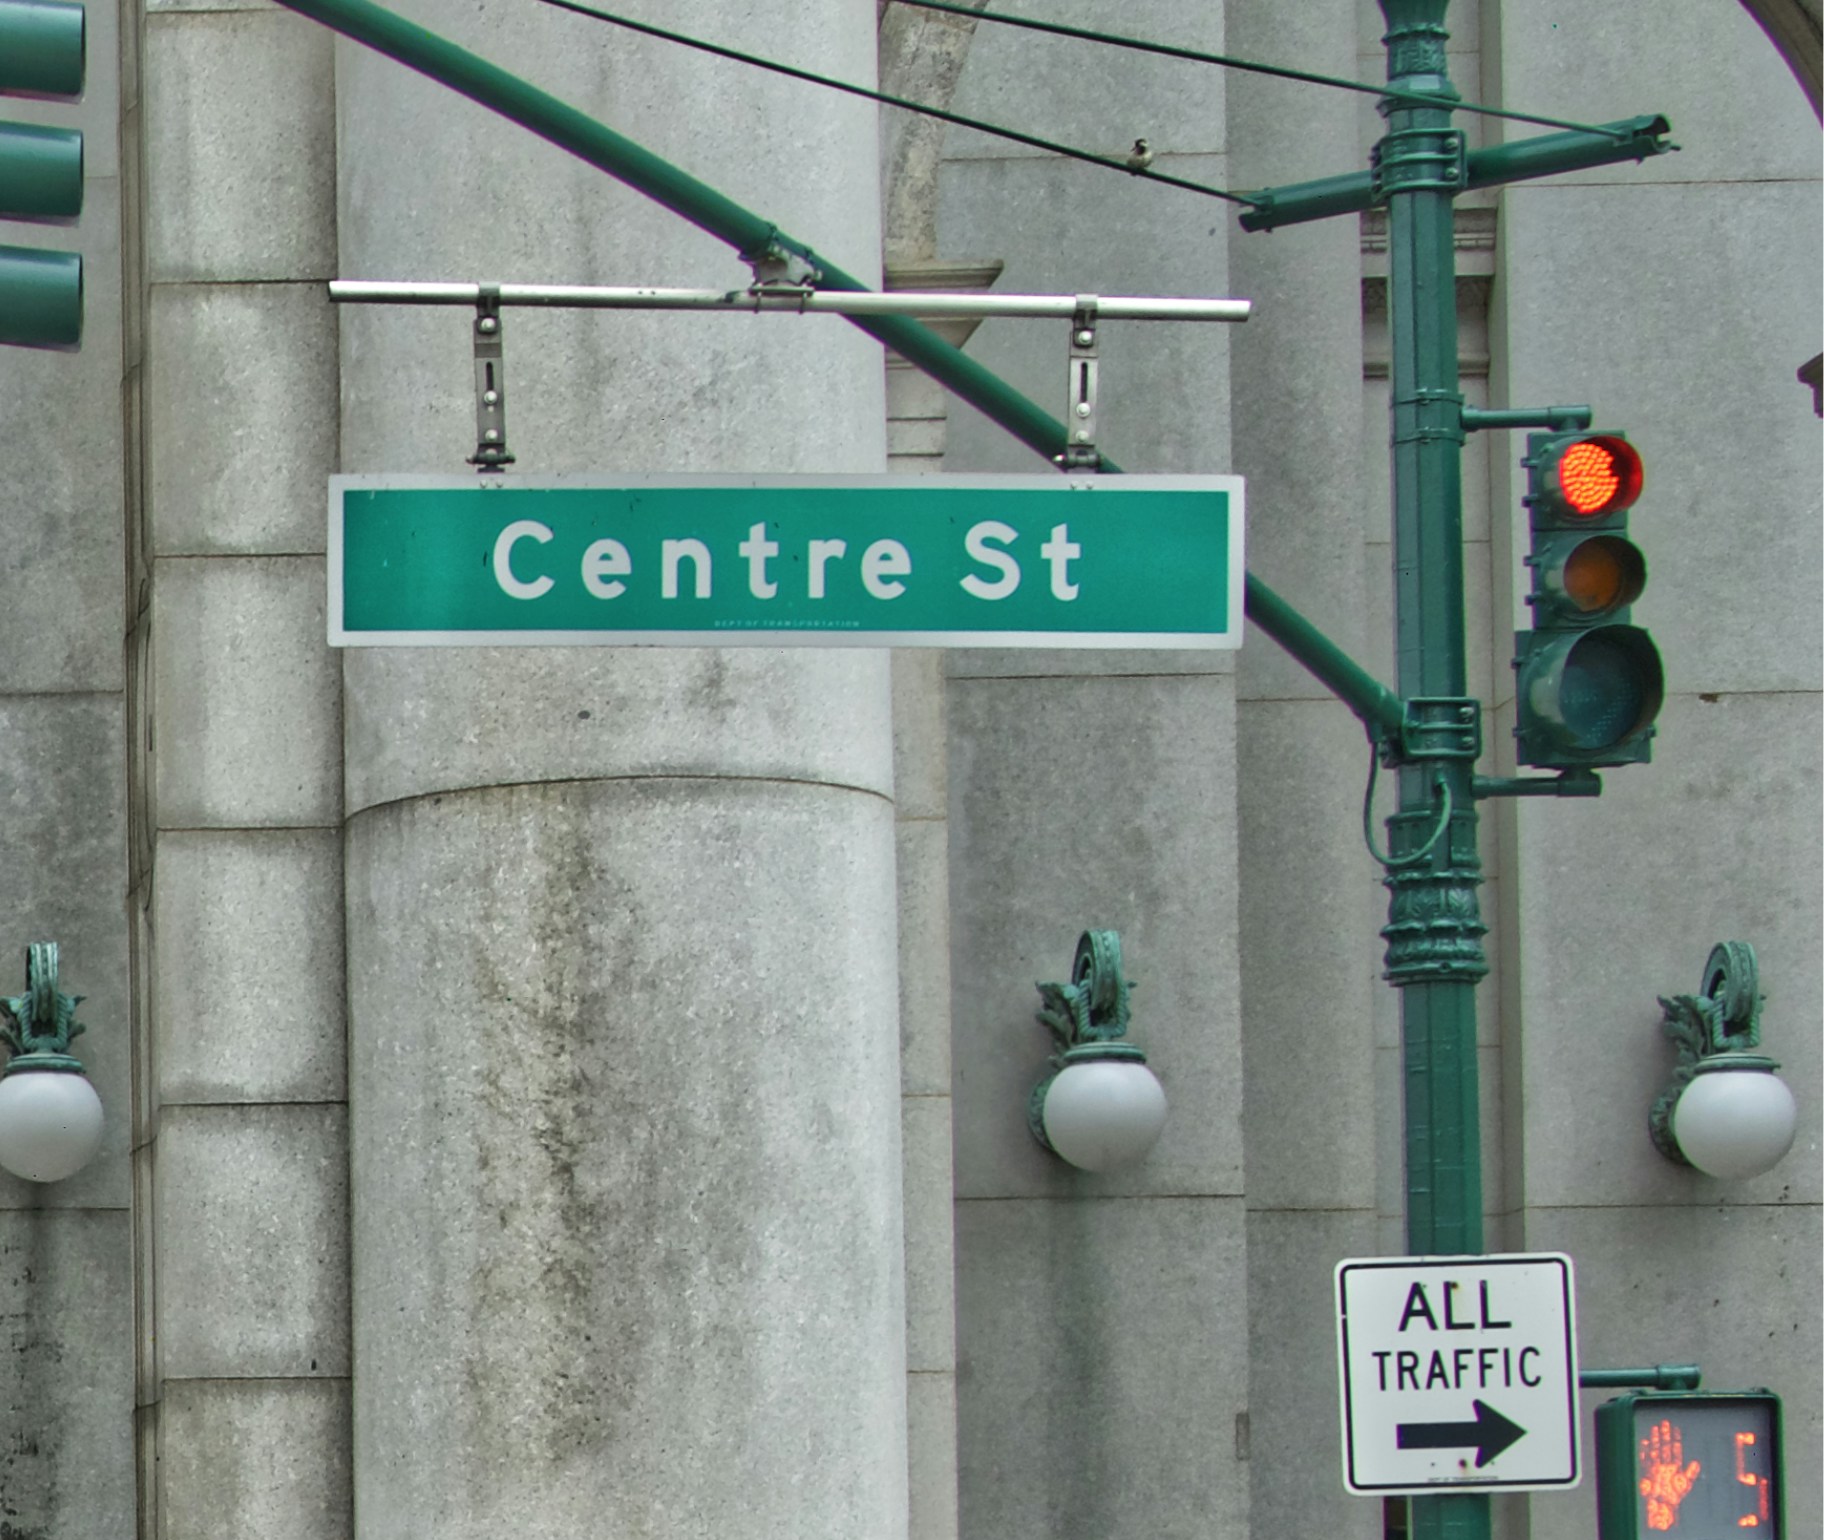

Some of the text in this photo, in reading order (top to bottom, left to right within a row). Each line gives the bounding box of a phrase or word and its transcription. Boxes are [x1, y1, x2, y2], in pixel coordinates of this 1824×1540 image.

[492, 519, 1082, 601] Centre St
[1398, 1279, 1513, 1332] ALL
[1371, 1346, 1542, 1392] TRAFFIC
[1734, 1431, 1769, 1528] 5
